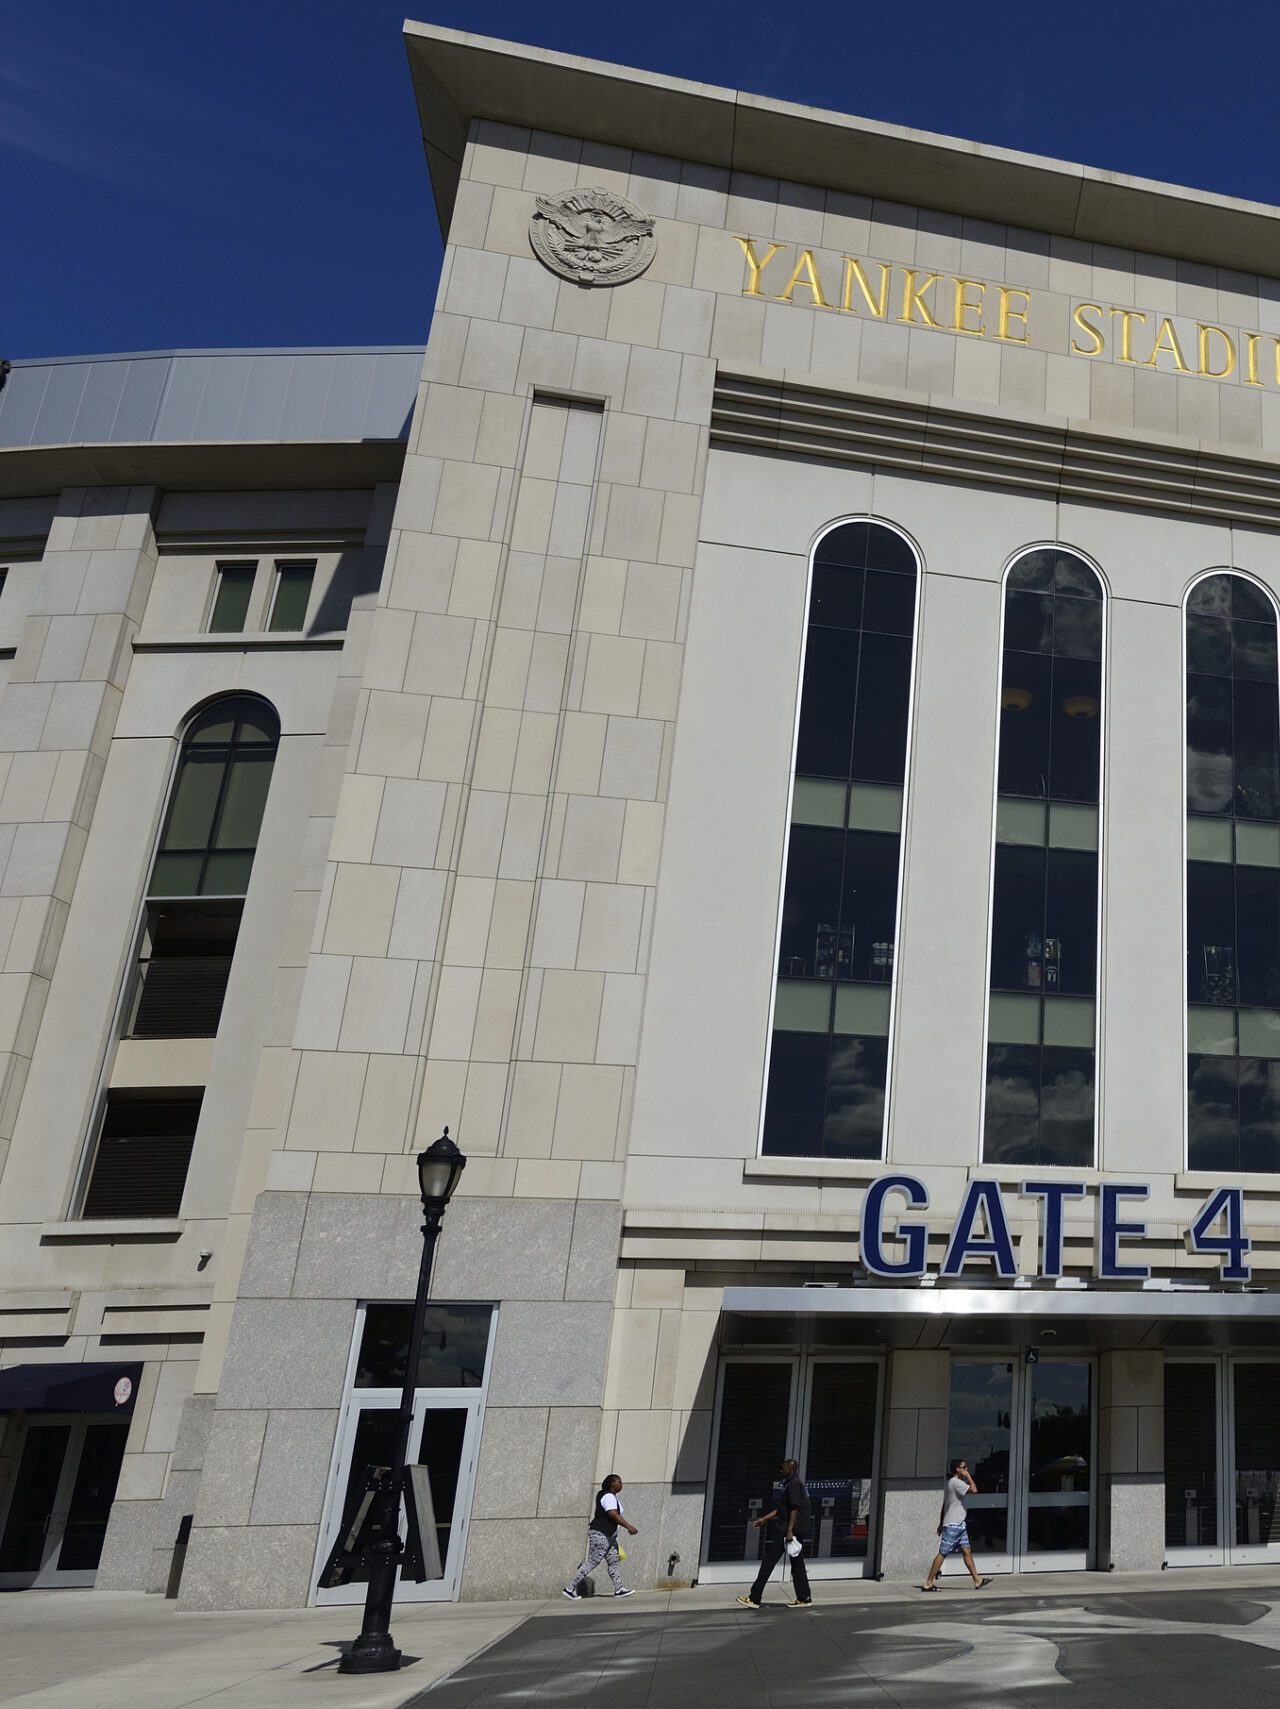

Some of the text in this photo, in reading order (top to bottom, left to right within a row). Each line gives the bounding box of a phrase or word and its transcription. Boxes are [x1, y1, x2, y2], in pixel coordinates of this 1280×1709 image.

[733, 236, 1030, 344] YANKEE
[859, 1173, 1251, 1283] GATE 4
